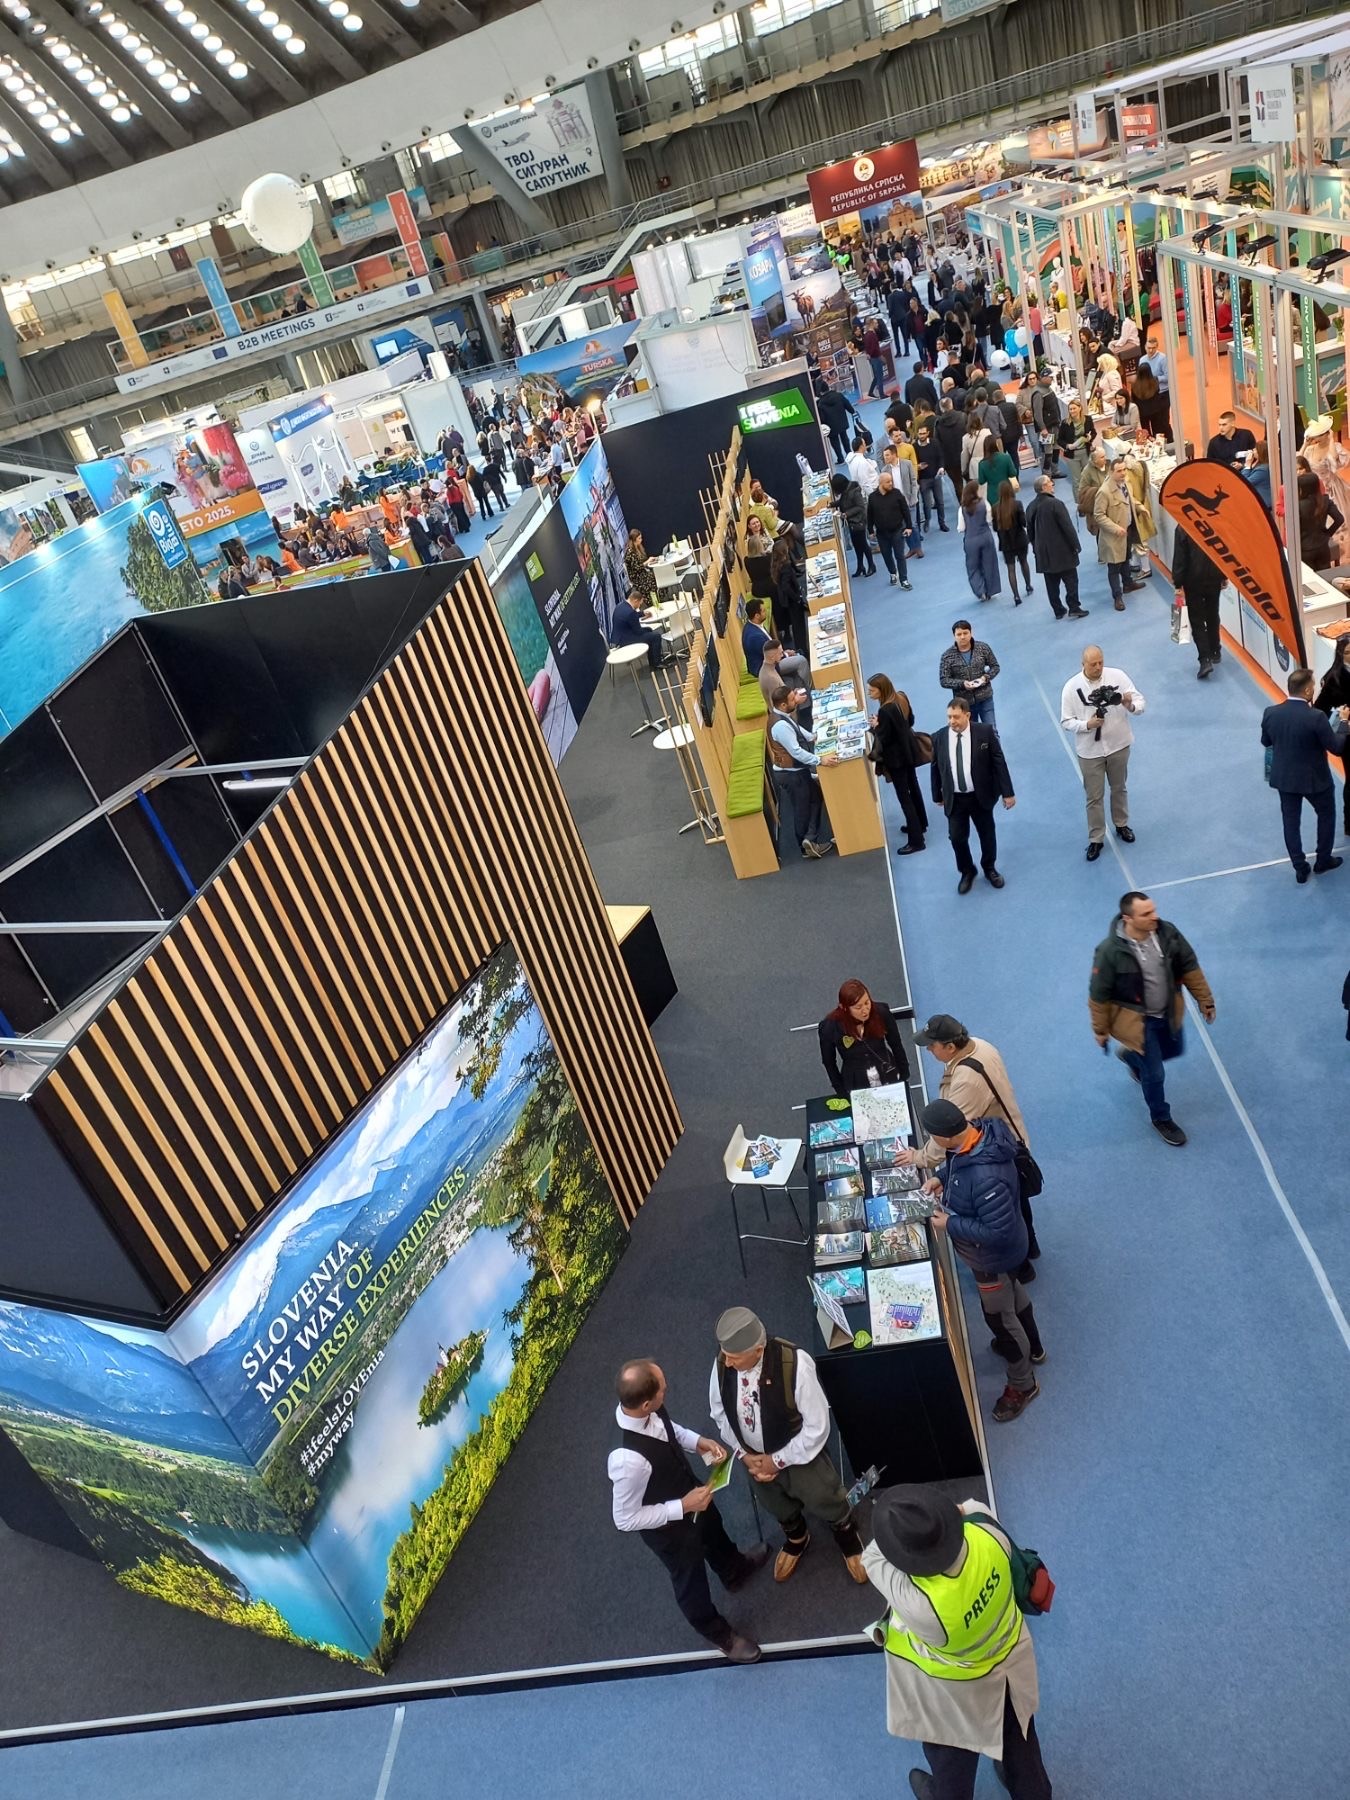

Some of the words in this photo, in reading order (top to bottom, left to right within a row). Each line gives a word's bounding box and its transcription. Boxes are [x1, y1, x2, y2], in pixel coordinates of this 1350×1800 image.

[504, 150, 535, 168] ТВОЈ
[515, 153, 570, 180] СИГУРАН
[525, 161, 591, 192] САПУТНИК
[830, 182, 876, 204] РЕПУБЛИКА
[874, 173, 905, 191] СРПСКА
[831, 196, 867, 214] REPUBLIC
[867, 192, 878, 204] OF
[878, 183, 907, 200] SRPSKA
[236, 336, 260, 351] B2B
[260, 319, 316, 343] MEETINGS
[582, 357, 614, 373] TURSKA
[740, 406, 748, 420] I
[743, 404, 800, 430] SLOVENIA
[179, 514, 204, 534] ETO
[206, 505, 236, 526] 2025.
[240, 1239, 360, 1380] SLOVENIA.
[270, 1310, 360, 1428] DIVERSE
[357, 1165, 471, 1318] EXPERIENCES.
[255, 1346, 299, 1405] MY
[294, 1283, 346, 1354] WAY
[345, 1247, 375, 1290] OF
[299, 1349, 386, 1467] #ifeelsLOVEnia
[306, 1410, 357, 1478] #myway
[963, 1566, 1001, 1630] PRESS
